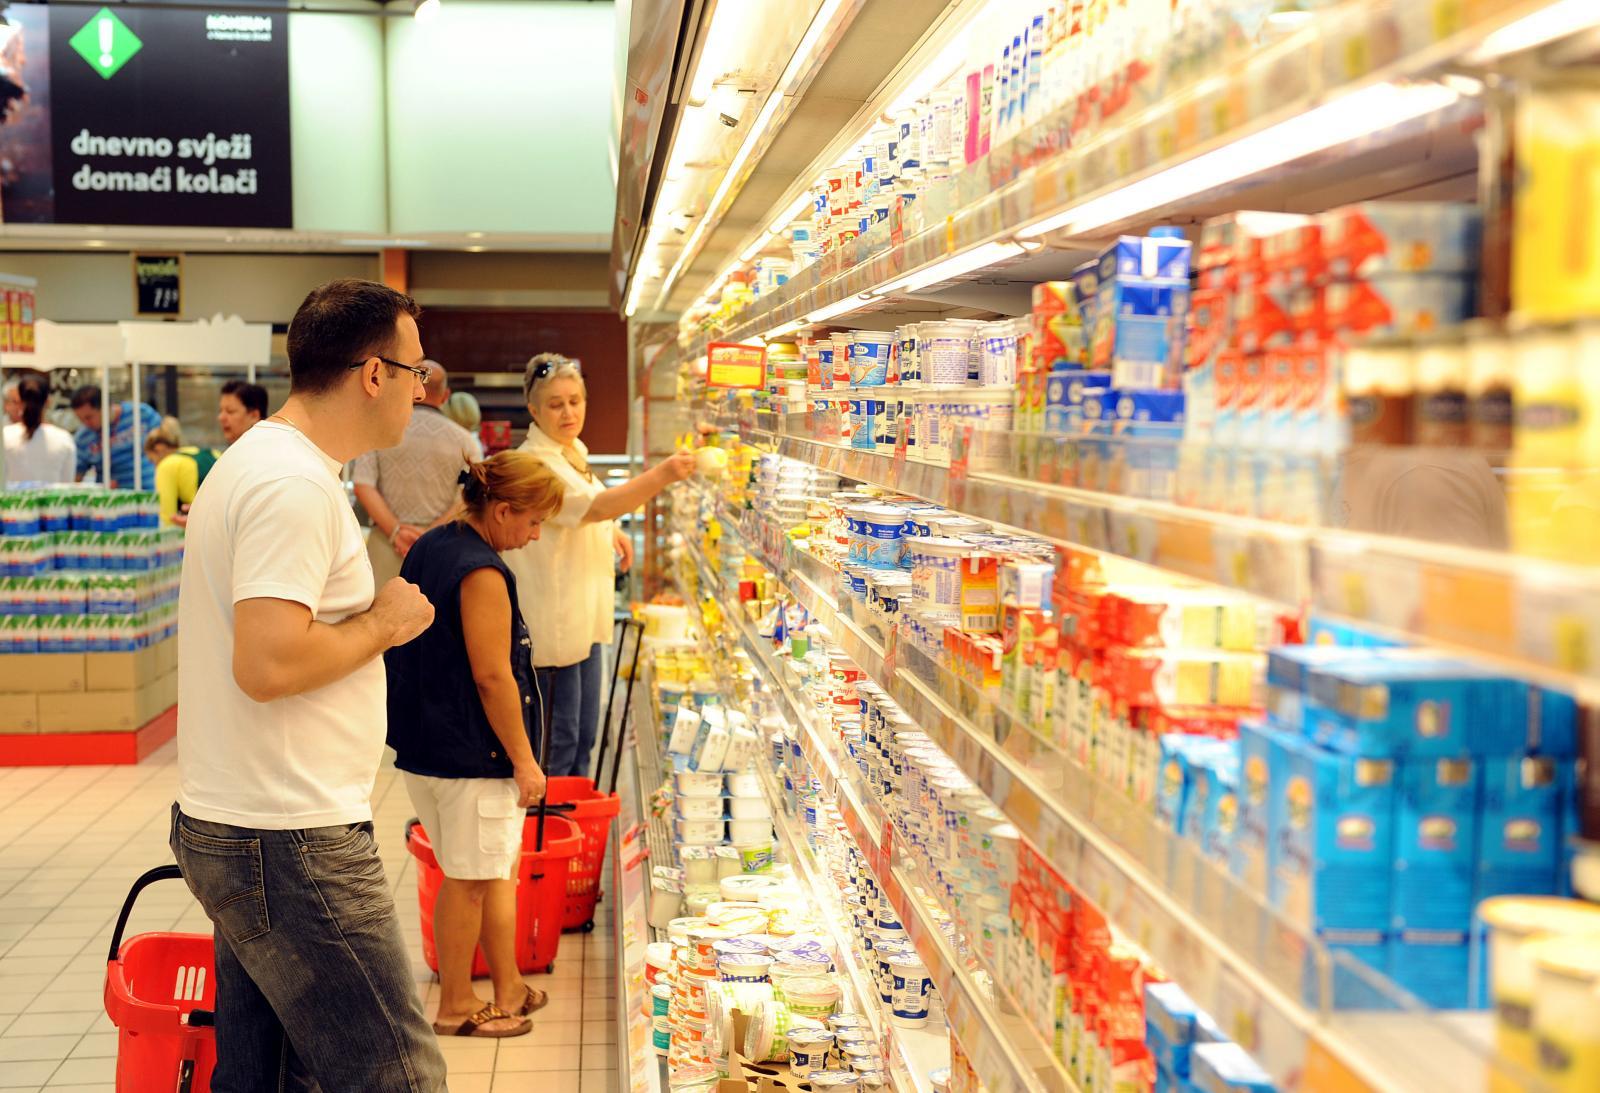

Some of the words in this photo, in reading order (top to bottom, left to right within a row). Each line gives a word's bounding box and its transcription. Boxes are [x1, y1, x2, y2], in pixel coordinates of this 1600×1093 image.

[71, 129, 173, 157] dnevno
[178, 133, 252, 165] svježi
[72, 165, 172, 192] domaći
[176, 166, 257, 194] kolači
